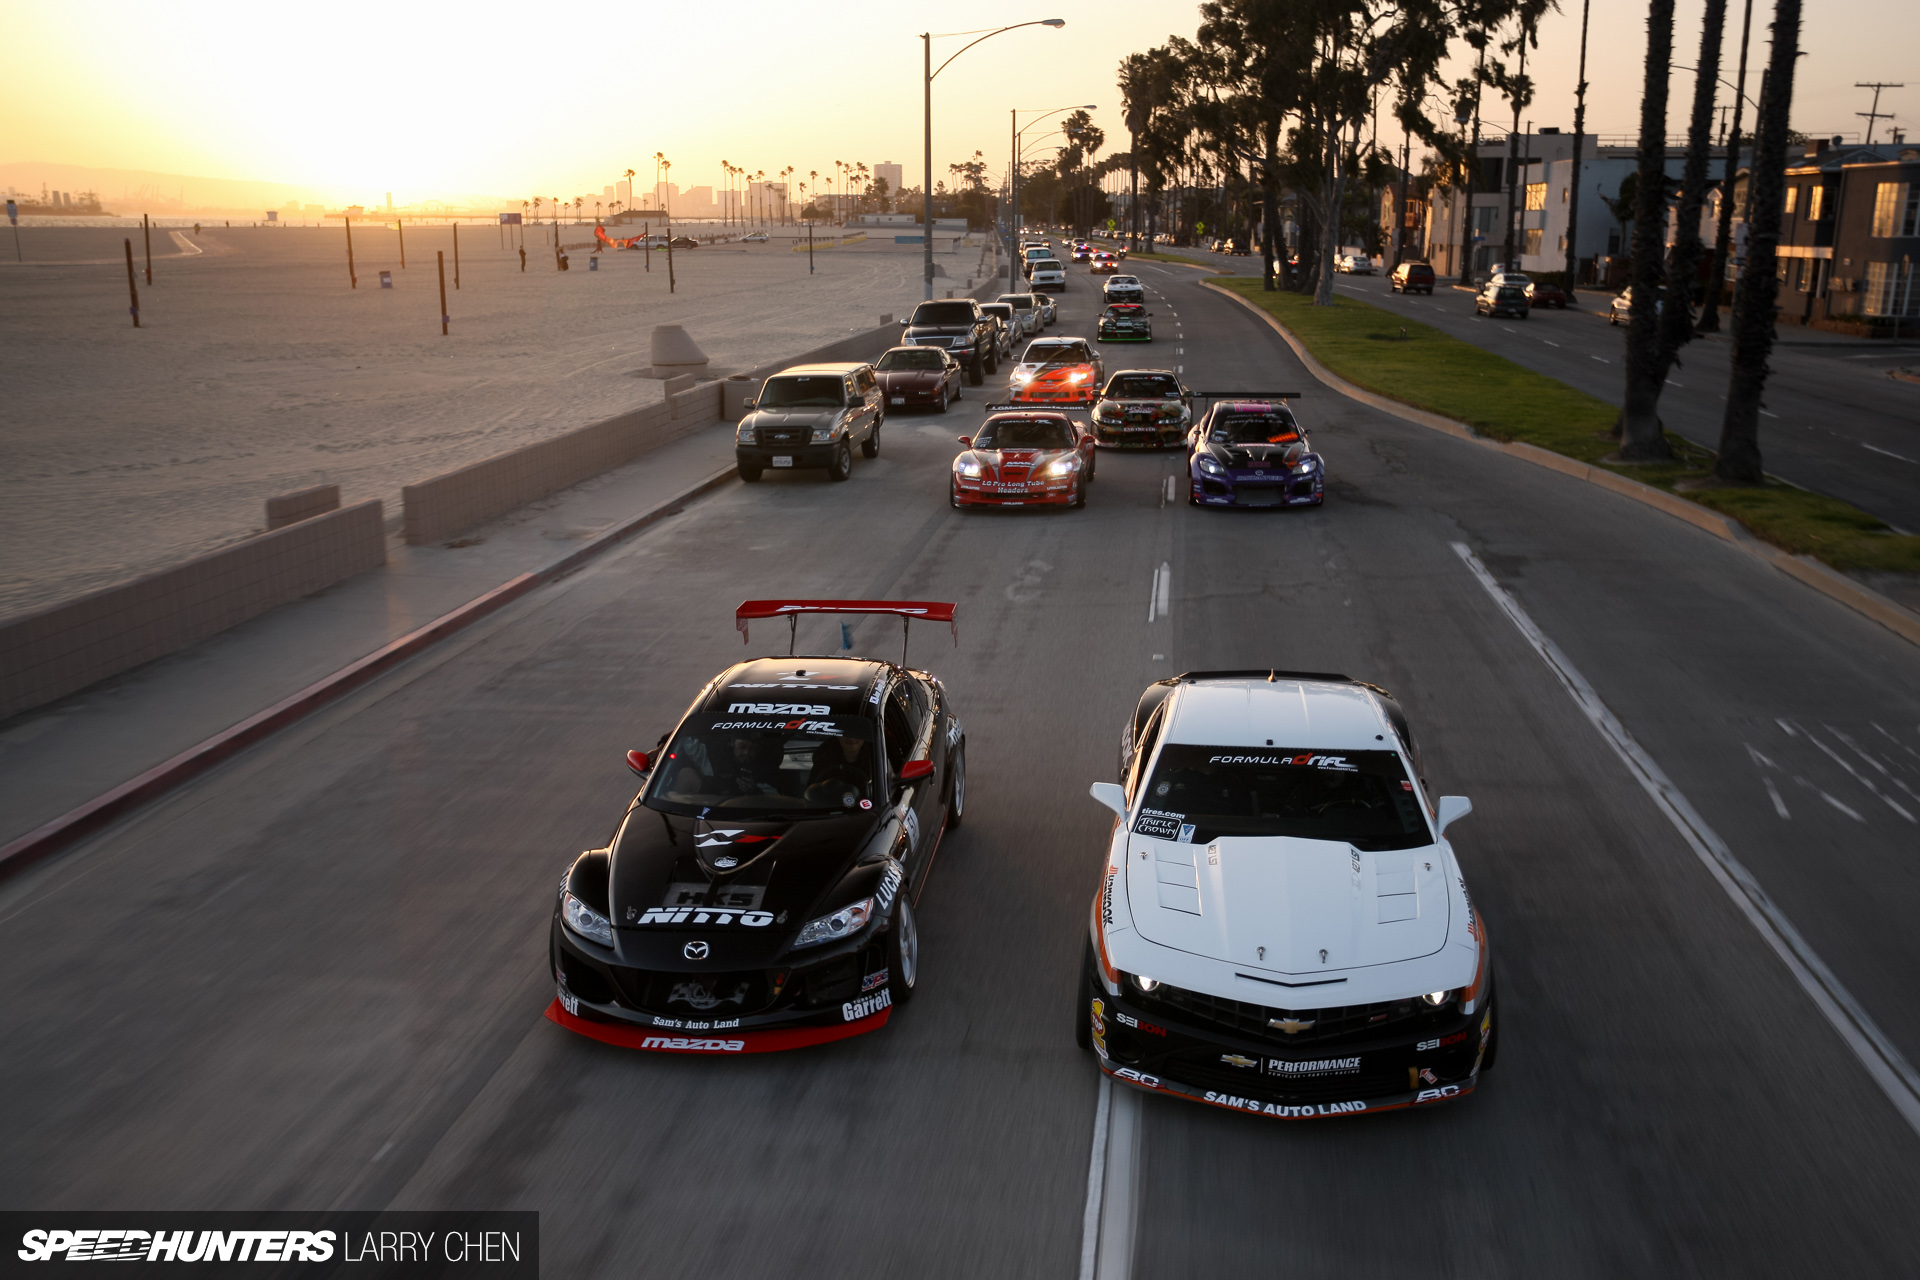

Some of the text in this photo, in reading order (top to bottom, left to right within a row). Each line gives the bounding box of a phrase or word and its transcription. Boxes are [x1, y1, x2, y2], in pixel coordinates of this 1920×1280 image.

[728, 683, 859, 691] NITTO
[1141, 807, 1186, 819] tires.com
[1138, 824, 1176, 836] CROWN
[1140, 817, 1176, 828] TRIPLE
[637, 907, 775, 927] NITTO
[842, 987, 892, 1022] Garrett
[652, 1016, 740, 1030] Sam's Auto Land
[1116, 1012, 1167, 1038] SEIBON
[1416, 1031, 1467, 1051] SEIBON
[1268, 1057, 1361, 1073] PERFORMANCE
[1268, 1071, 1300, 1079] VEHICLES
[1203, 1091, 1367, 1118] SAM'S AUTO LAND
